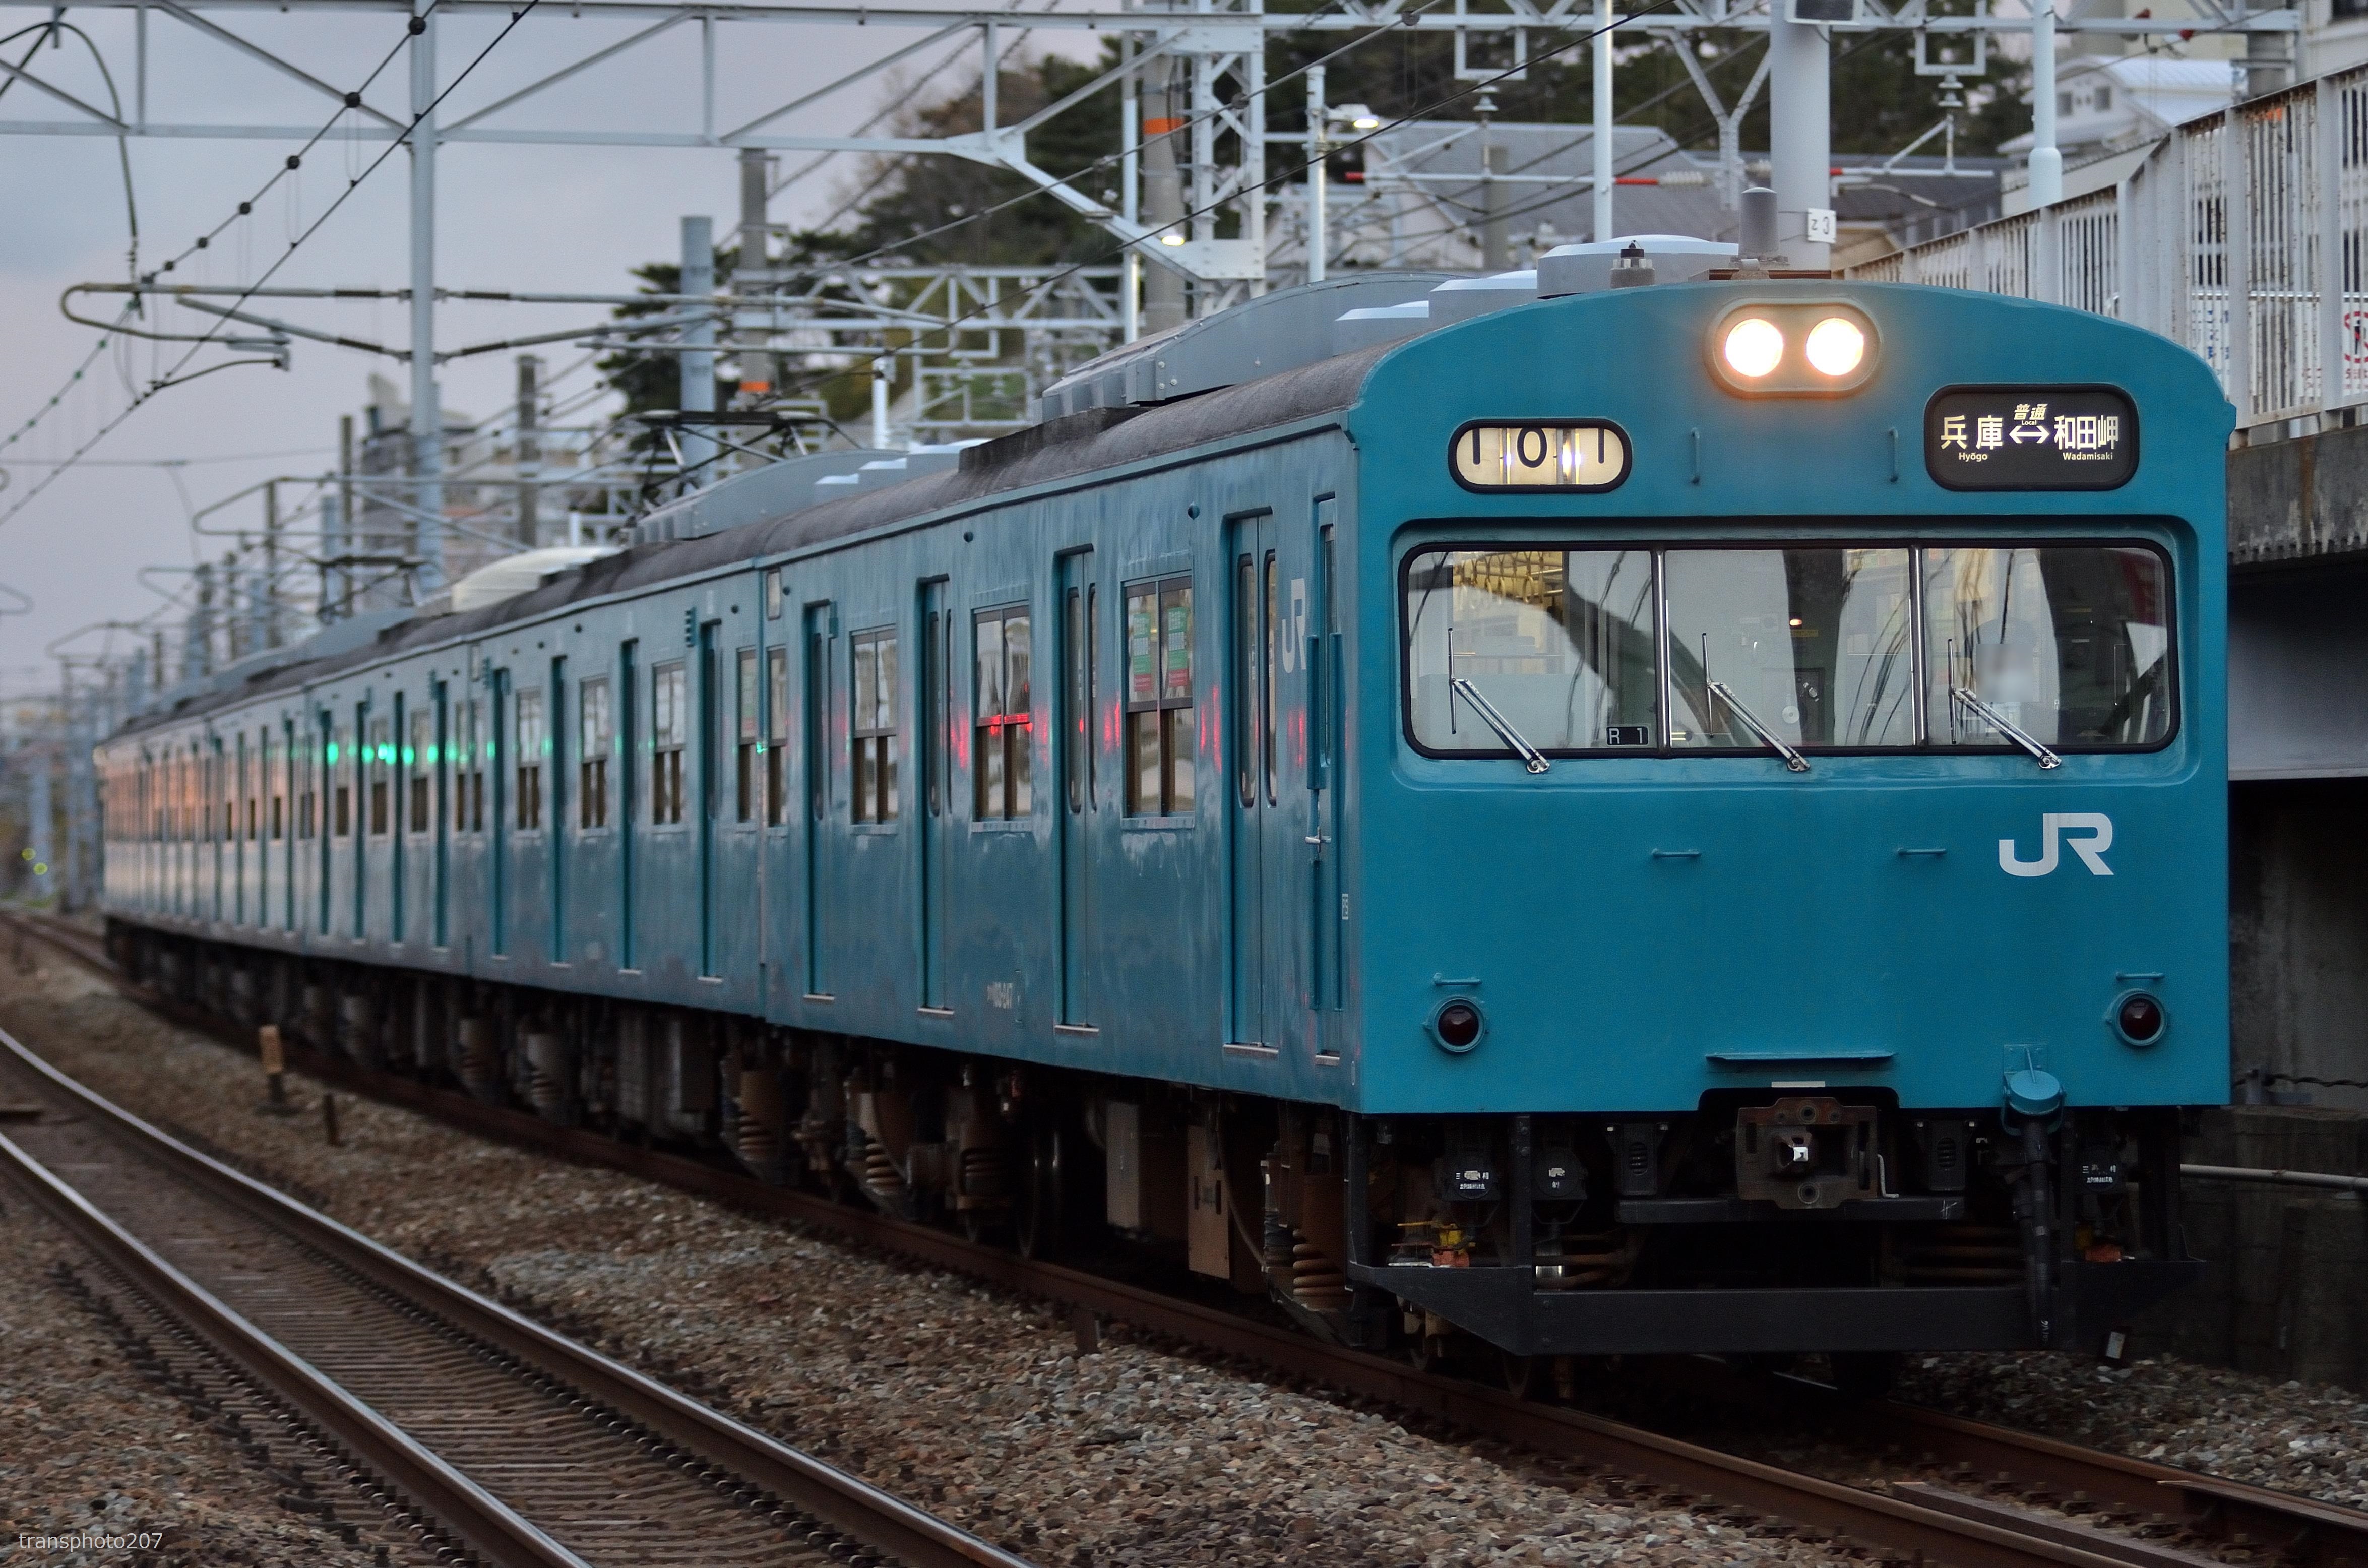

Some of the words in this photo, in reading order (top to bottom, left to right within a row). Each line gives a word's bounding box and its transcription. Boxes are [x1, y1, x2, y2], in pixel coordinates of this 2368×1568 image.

[2014, 403, 2048, 420] 普通
[1941, 414, 2003, 450] 兵庫
[2054, 414, 2119, 450] 和田岬
[1959, 452, 1987, 462] Hyōgo
[2063, 452, 2113, 460] Wadamisaki
[1282, 578, 1306, 674] JR
[1609, 728, 1620, 744] R
[1637, 728, 1643, 744] 1
[1999, 812, 2114, 877] JR
